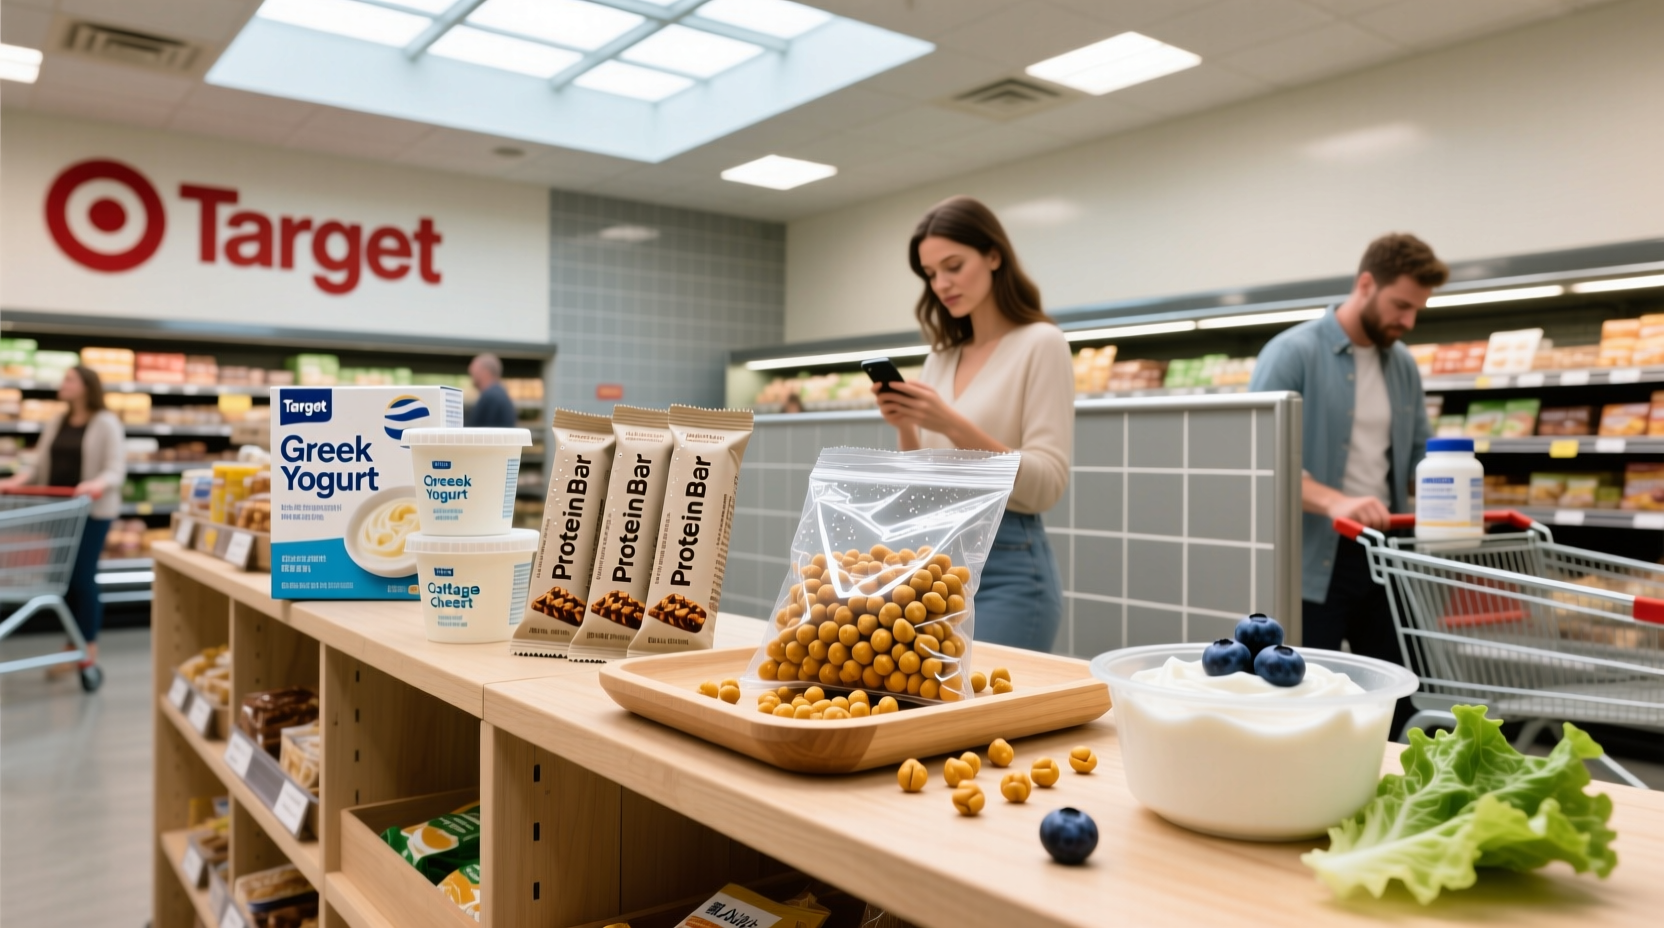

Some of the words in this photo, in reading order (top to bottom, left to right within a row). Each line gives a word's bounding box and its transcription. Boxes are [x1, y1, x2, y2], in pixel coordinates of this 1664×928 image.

[180, 184, 442, 295] Target
[280, 434, 374, 464] Greek
[280, 465, 380, 499] Yogurt
[426, 488, 468, 504] Yogurt
[566, 453, 592, 496] Bar
[626, 453, 652, 496] Bar
[685, 455, 711, 499] Bar
[551, 498, 585, 581] Protein
[612, 498, 646, 584] Protein
[670, 501, 704, 587] Protein
